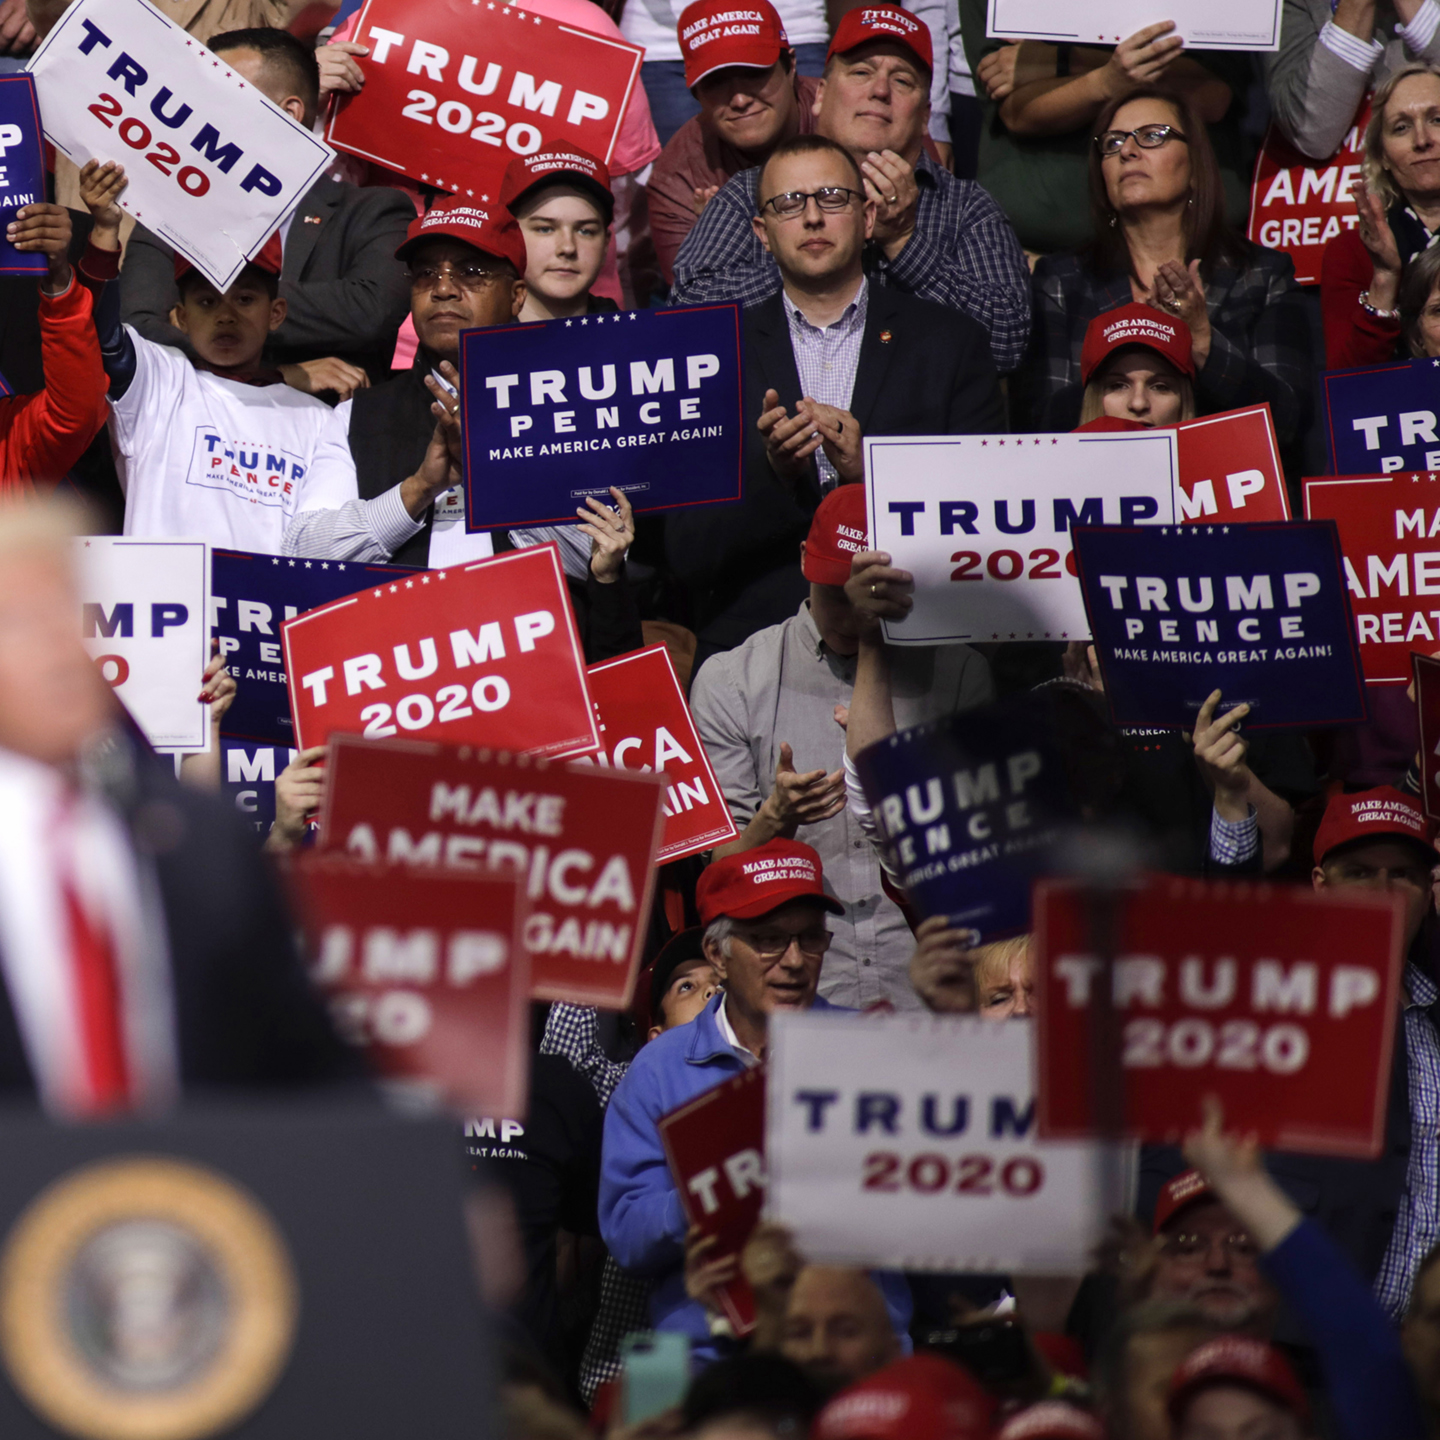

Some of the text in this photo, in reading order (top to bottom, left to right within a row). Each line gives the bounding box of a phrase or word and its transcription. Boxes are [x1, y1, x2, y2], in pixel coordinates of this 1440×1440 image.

[683, 10, 764, 40] MAKE AMERICA
[689, 24, 760, 50] GREAT AGAIN
[861, 9, 918, 33] Trump
[871, 21, 906, 35] 2020
[368, 26, 609, 126] TRUMP
[77, 18, 283, 197] TRUMP
[402, 90, 542, 156] 2020
[87, 93, 211, 197] 2020
[524, 152, 597, 170] MAKE AMERICA
[530, 162, 593, 176] GREAT AGAIN
[445, 207, 489, 220] AMERICA
[449, 216, 482, 228] AGAIN
[1103, 318, 1176, 337] MAKE AMERICA
[1107, 329, 1171, 343] GREAT AGAIN
[485, 354, 720, 409] TRUMP
[510, 397, 700, 438] PENCE
[490, 426, 723, 461] MAKE AMERICA GREAT AGAIN!
[211, 457, 293, 495] PENCE
[836, 524, 864, 541] MAKE
[888, 496, 1159, 536] TRUMP
[1100, 572, 1321, 613] TRUMP
[1125, 616, 1304, 642] PENCE
[302, 610, 555, 707] TRUMP
[1114, 645, 1332, 664] MAKE AMERICA GREAT AGAIN!
[246, 668, 288, 684] AMER
[360, 675, 511, 741] 2020
[430, 782, 566, 837] MAKE
[882, 751, 1042, 838] RUMP
[1351, 800, 1382, 814] MAKE
[1358, 811, 1392, 823] GREAT
[743, 859, 775, 874] MAKE
[753, 870, 788, 884] GREAT
[523, 912, 631, 964] GAIN
[1054, 953, 1381, 1019] TRUMP
[1121, 1016, 1310, 1077] 2020
[793, 1089, 1037, 1141] TRUM
[862, 1150, 1047, 1200] 2020
